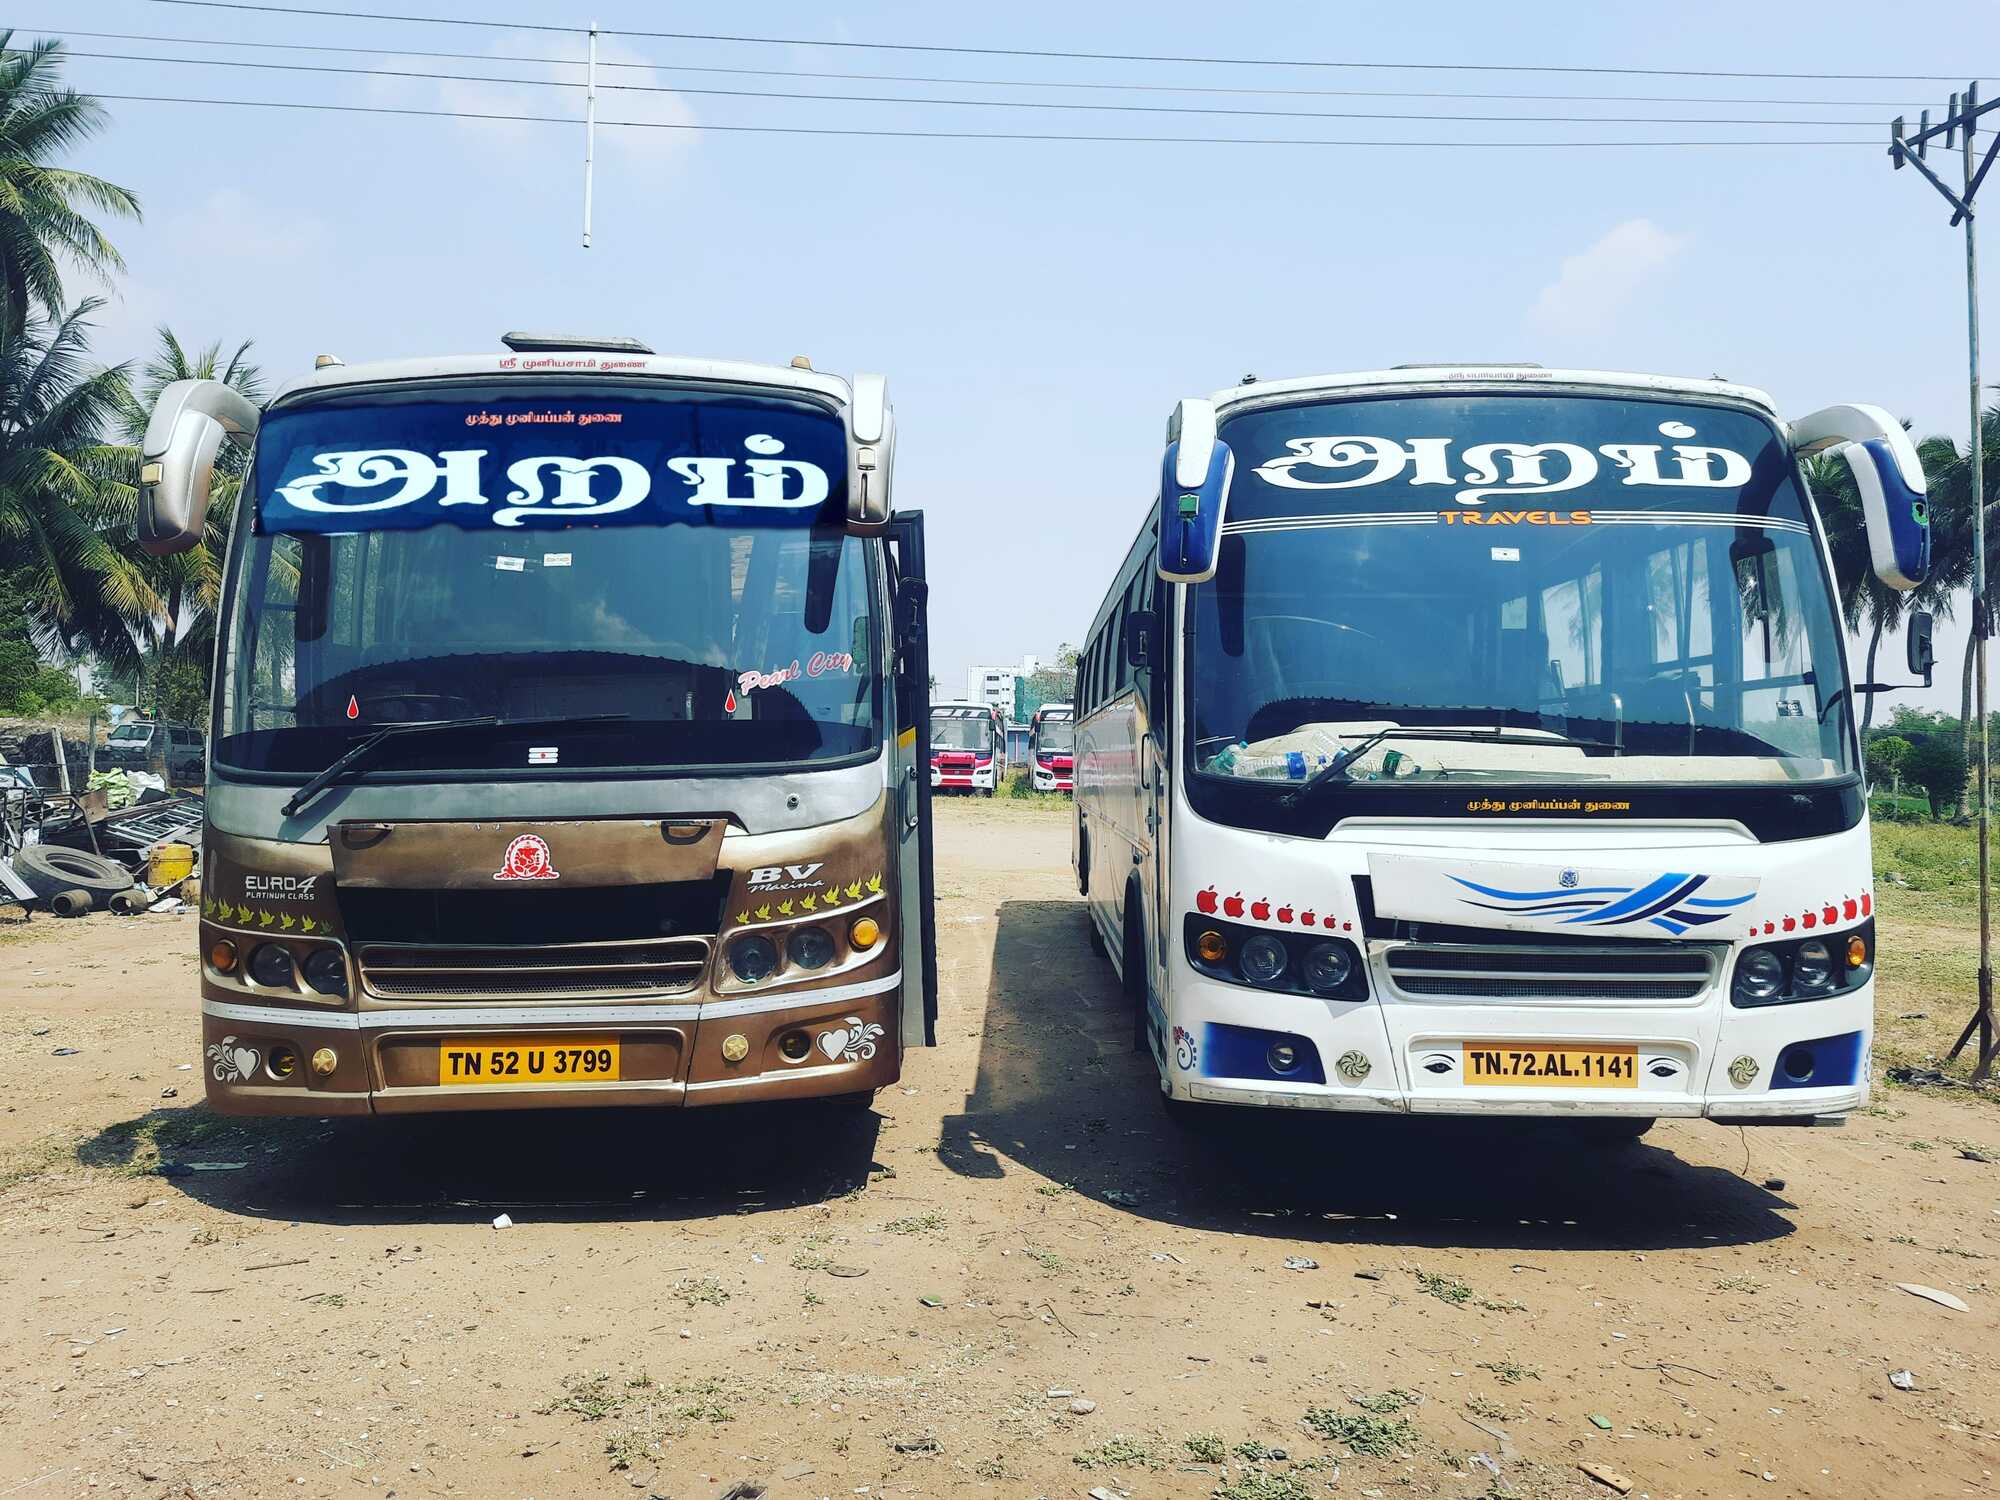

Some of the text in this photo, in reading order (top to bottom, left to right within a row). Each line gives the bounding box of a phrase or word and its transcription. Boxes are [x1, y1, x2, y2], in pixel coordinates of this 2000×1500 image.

[600, 361, 646, 371] துணை
[465, 410, 623, 426] முத்து முனியப்பன் துணை
[1250, 420, 1753, 505] அறம்
[274, 433, 829, 527] அறம்
[1438, 510, 1593, 526] TRAVELS
[737, 651, 853, 696] Pearl City
[1466, 798, 1632, 812] முத்து முனியப்பன் துணை
[746, 862, 825, 885] BV
[246, 891, 315, 901] PLATINUM CLASS
[448, 1049, 612, 1076] TN 52 U 3799
